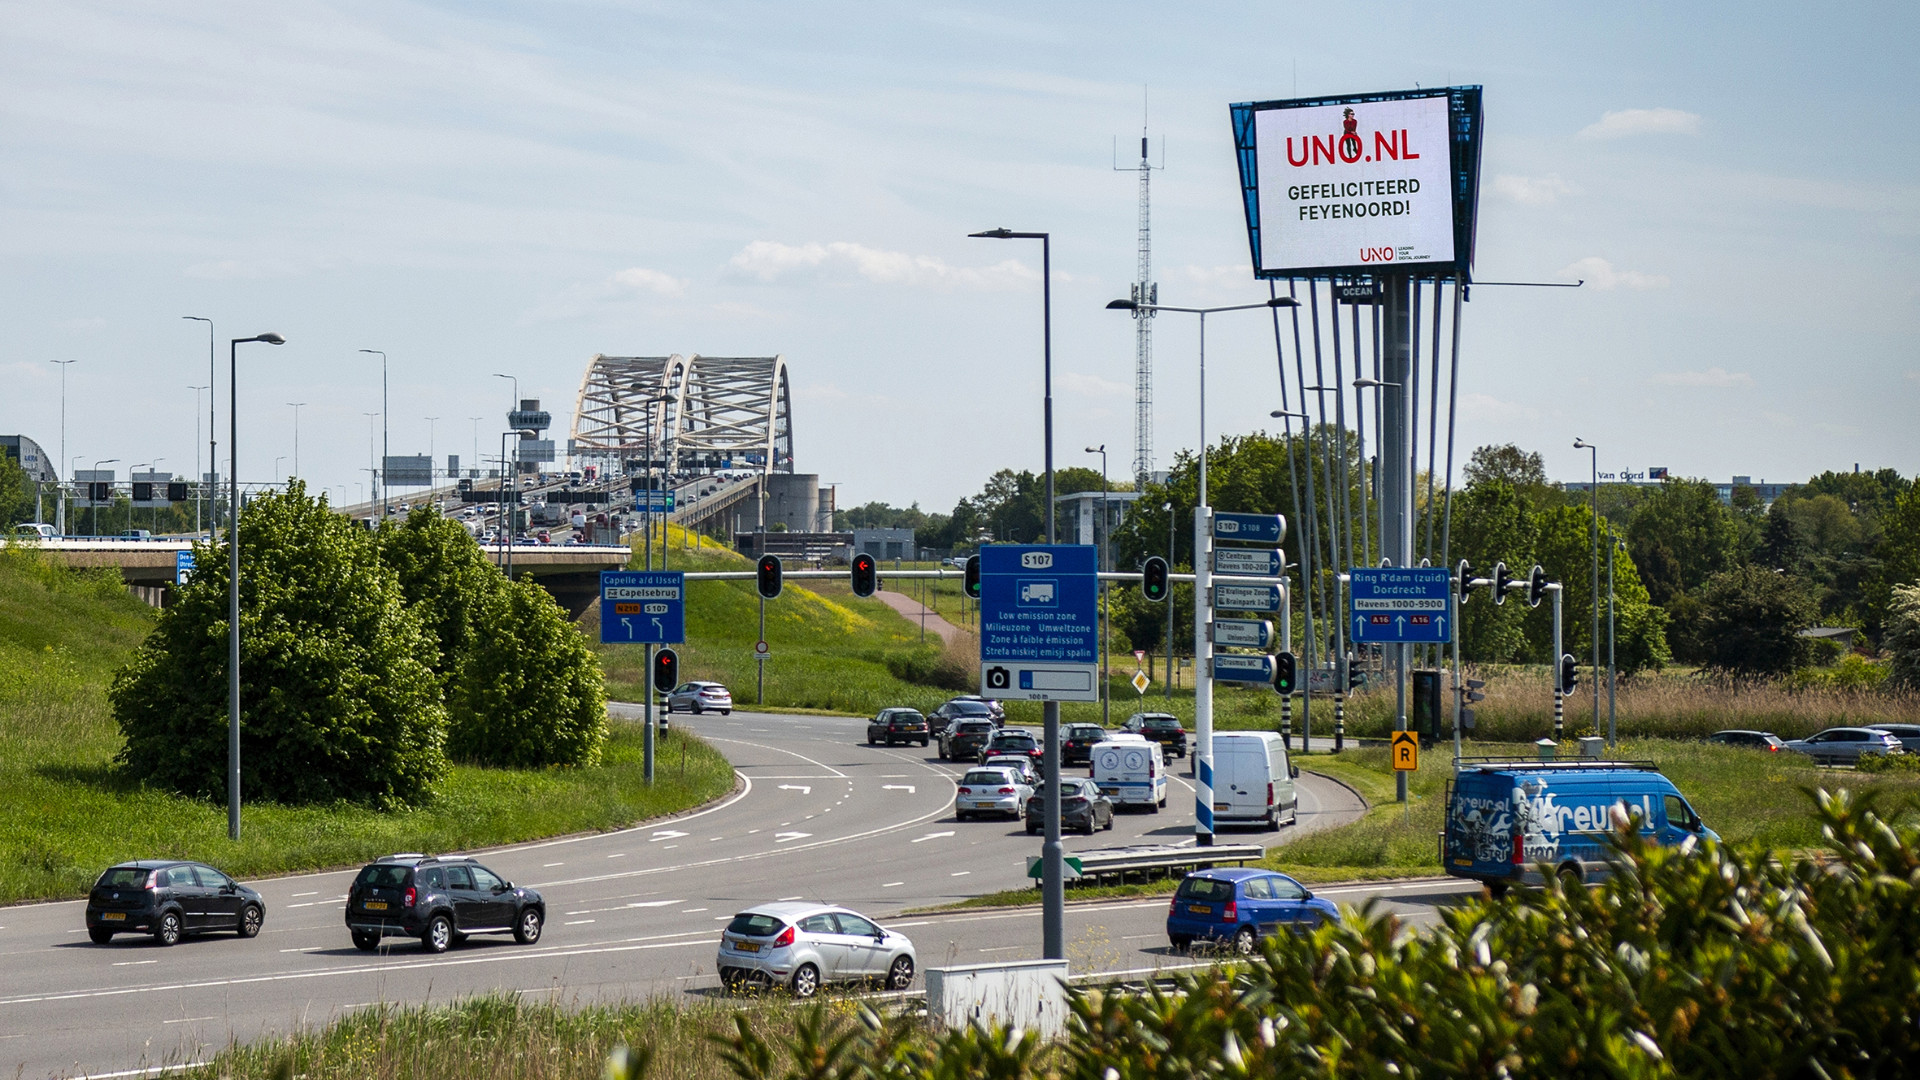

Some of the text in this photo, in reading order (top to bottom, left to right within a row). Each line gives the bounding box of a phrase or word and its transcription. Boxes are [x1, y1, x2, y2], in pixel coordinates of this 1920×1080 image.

[1286, 129, 1420, 167] UNO.NL
[1287, 178, 1421, 201] GEFELICITEERD
[1299, 200, 1411, 221] FEYENOORD!
[1360, 246, 1394, 262] UNO
[1343, 287, 1373, 296] OCEAN
[1620, 472, 1644, 480] Oord
[1032, 555, 1050, 565] 107
[1218, 562, 1240, 570] Havens
[604, 576, 680, 586] Capelle a/d IJssel
[1354, 574, 1446, 584] Ring R'dam (zuid)
[620, 588, 676, 598] Capelsebrug
[1373, 586, 1426, 594] Dordrecht
[1226, 598, 1256, 606] Brainpark
[1357, 600, 1443, 608] Havens 1000-9900
[999, 611, 1015, 620] Low
[1017, 611, 1054, 620] emission
[986, 623, 1092, 633] Milieuzone Umweltzone
[990, 634, 1084, 645] Zone à faible émission
[986, 646, 1092, 659] Strefa niskiej emisji spalin
[1400, 748, 1410, 762] R
